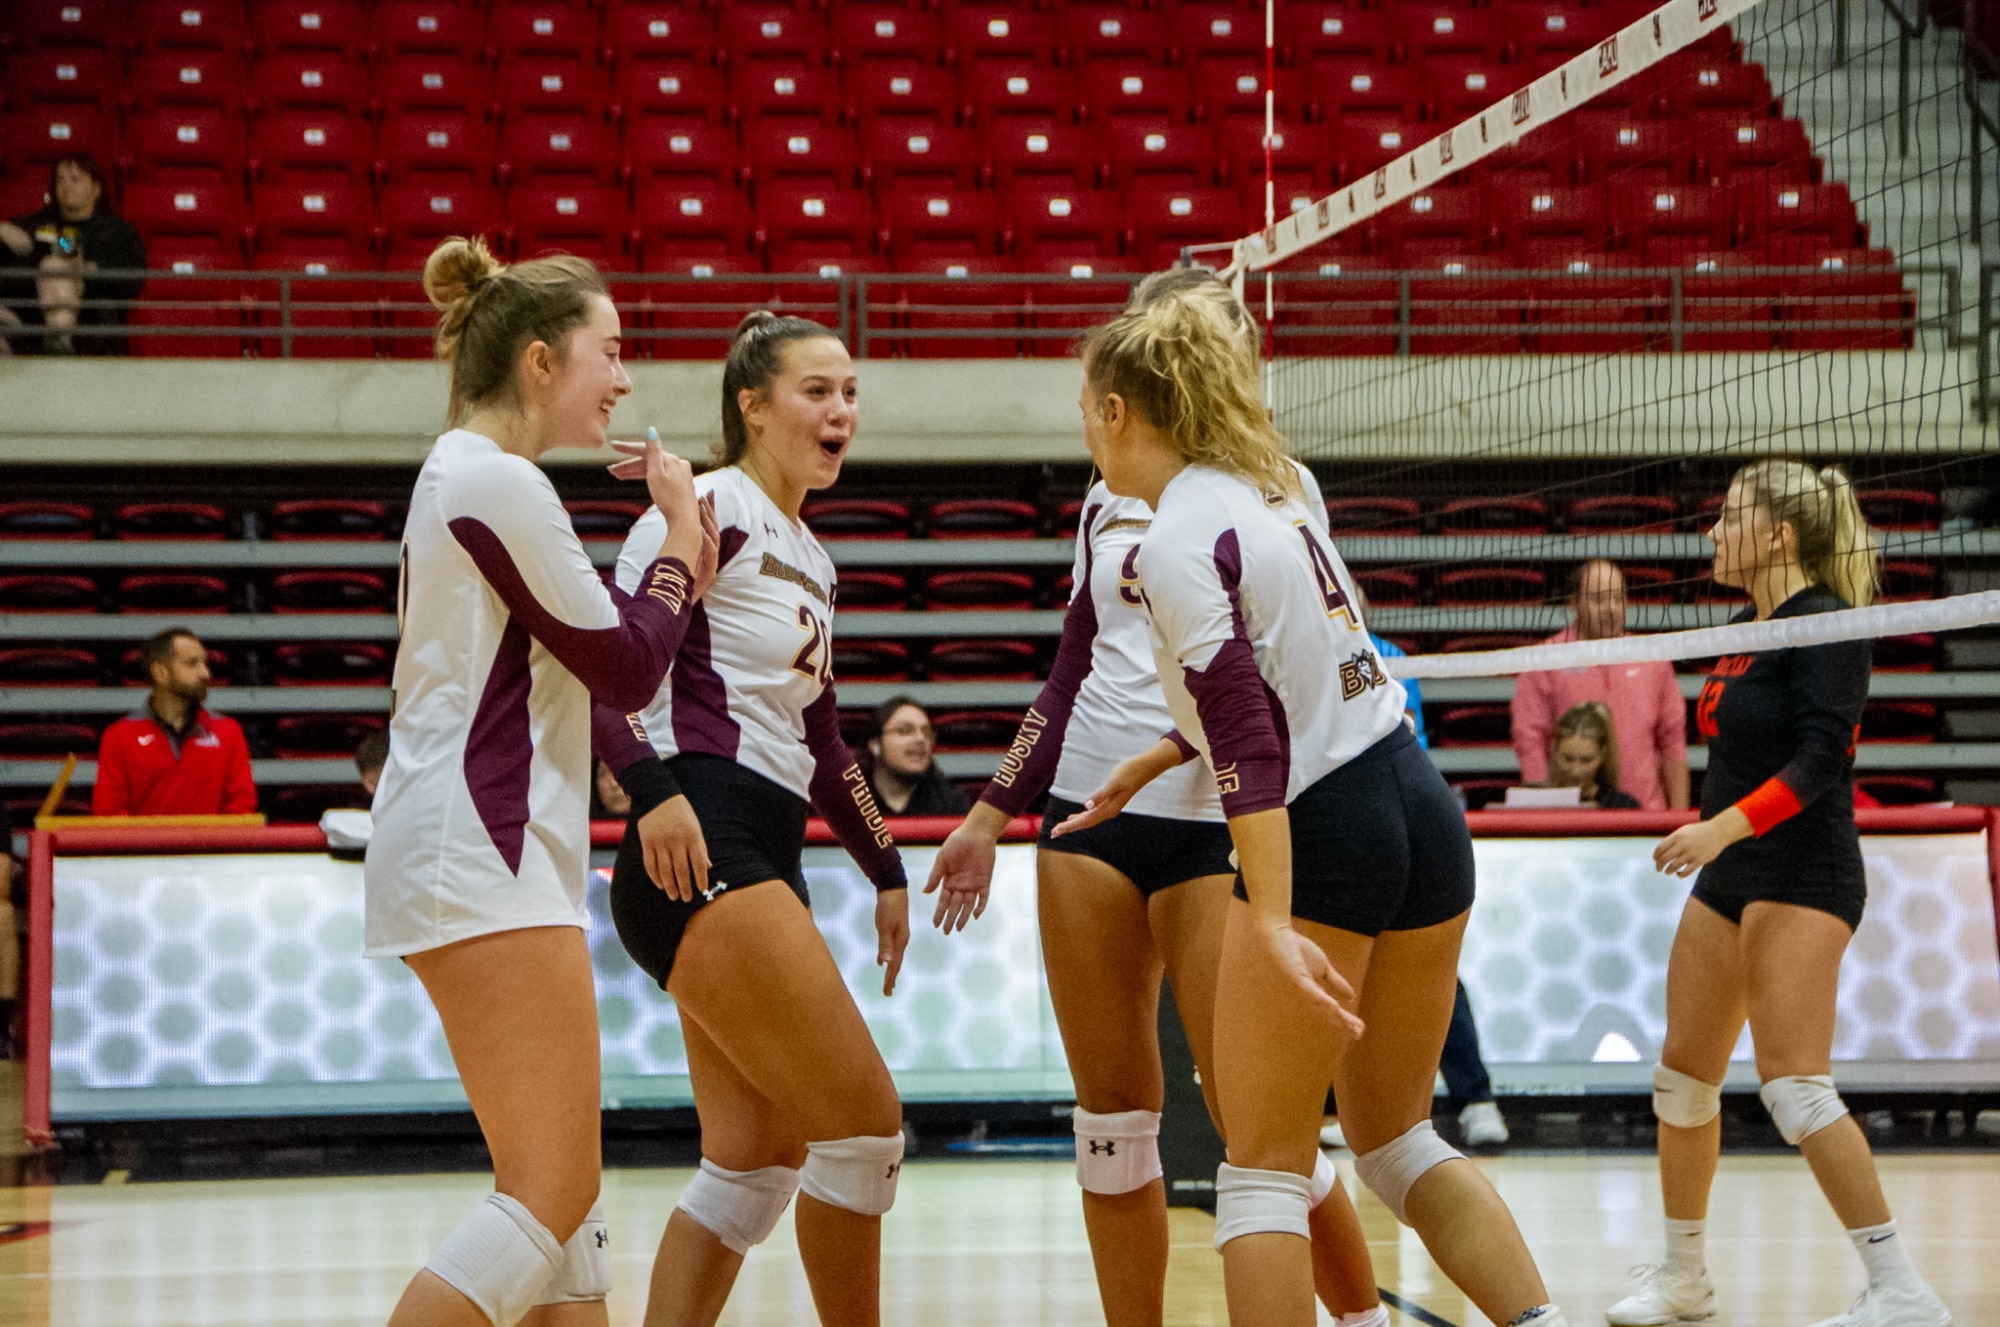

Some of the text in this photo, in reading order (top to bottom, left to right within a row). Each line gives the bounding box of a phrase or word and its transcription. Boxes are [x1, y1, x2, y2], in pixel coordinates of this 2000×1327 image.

[1292, 519, 1361, 631] 4
[992, 707, 1048, 788] HUSKY
[842, 763, 893, 849] PRIDE
